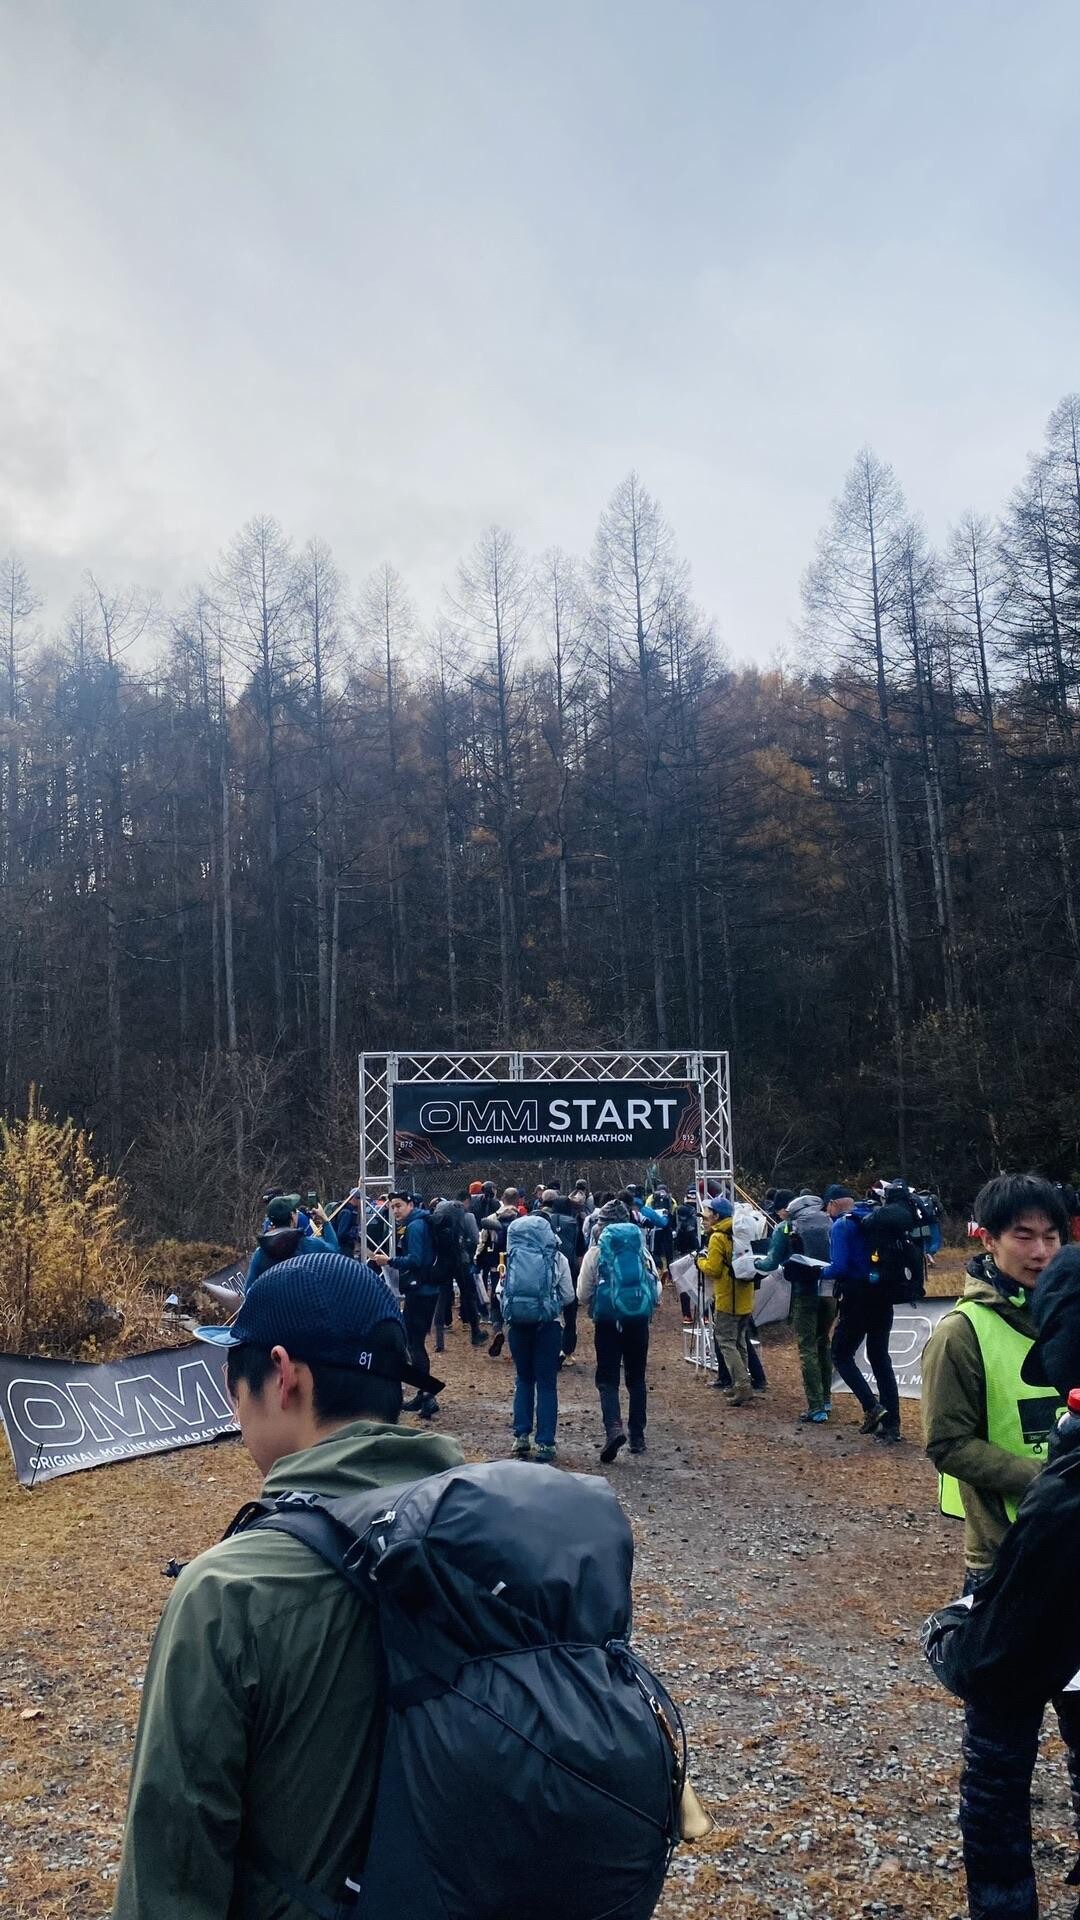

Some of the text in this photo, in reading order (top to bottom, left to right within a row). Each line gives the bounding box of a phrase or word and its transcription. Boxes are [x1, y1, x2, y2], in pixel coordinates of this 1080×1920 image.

[419, 1099, 678, 1133] OMM START
[467, 1133, 633, 1145] ORIGINAL MOUNTAIN MARATHON
[359, 1351, 373, 1371] 81
[7, 1360, 234, 1447] OMM
[29, 1451, 101, 1470] ORIGINAL
[100, 1434, 173, 1457] MOUNTAIN
